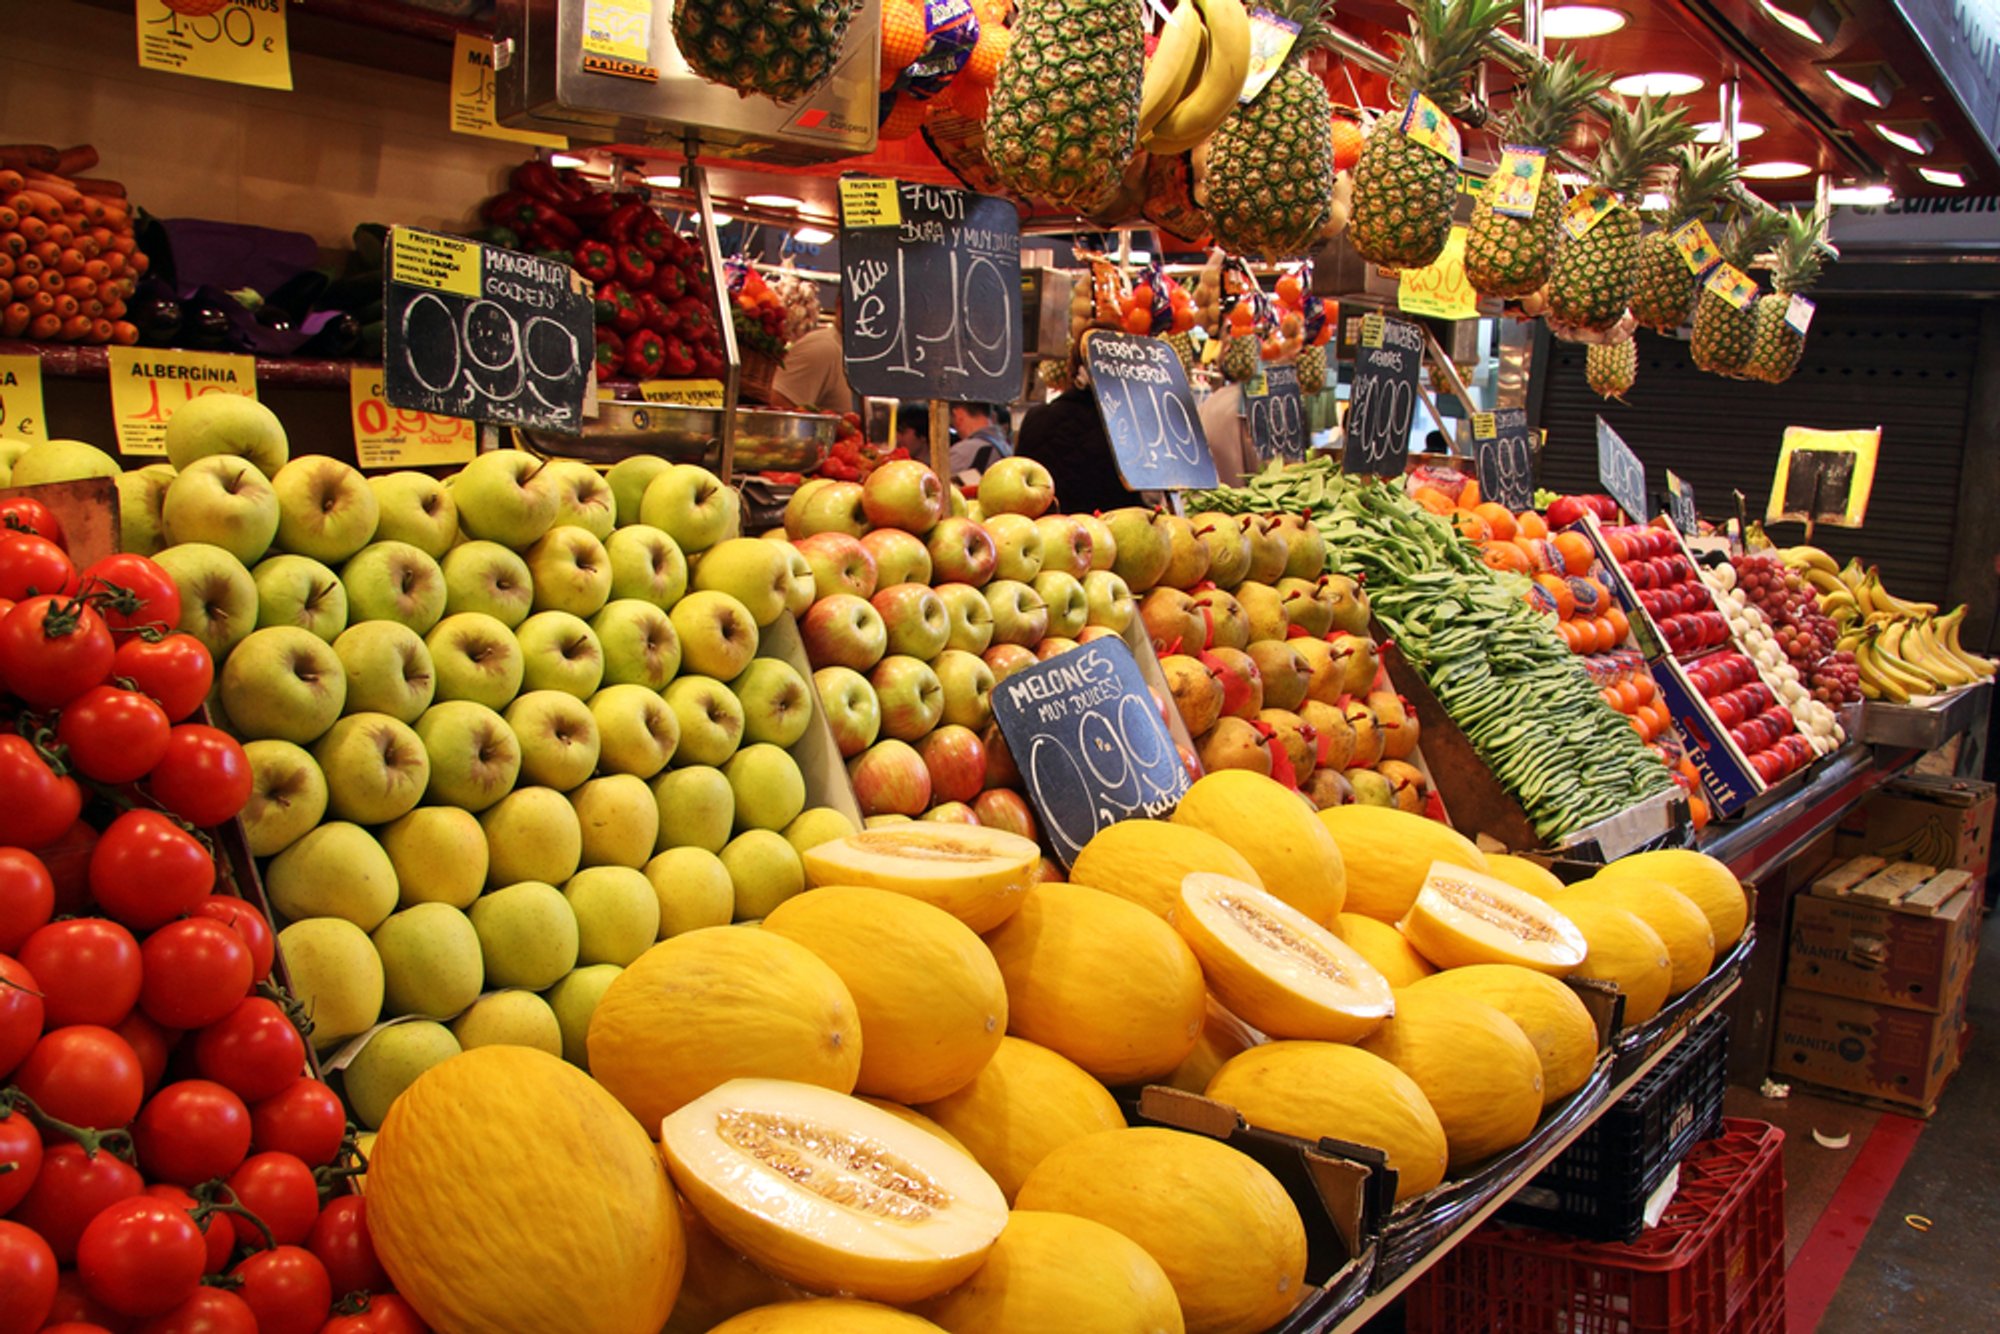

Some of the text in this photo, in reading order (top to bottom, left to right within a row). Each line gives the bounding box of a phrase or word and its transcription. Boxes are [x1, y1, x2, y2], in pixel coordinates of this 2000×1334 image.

[844, 247, 1012, 378] 1,19
[131, 362, 238, 384] ALBERGÍNIA
[1008, 648, 1115, 711] MELONES
[1037, 697, 1068, 724] MUY
[1689, 746, 1737, 806] Fruit
[1783, 1031, 1839, 1053] WANITA
